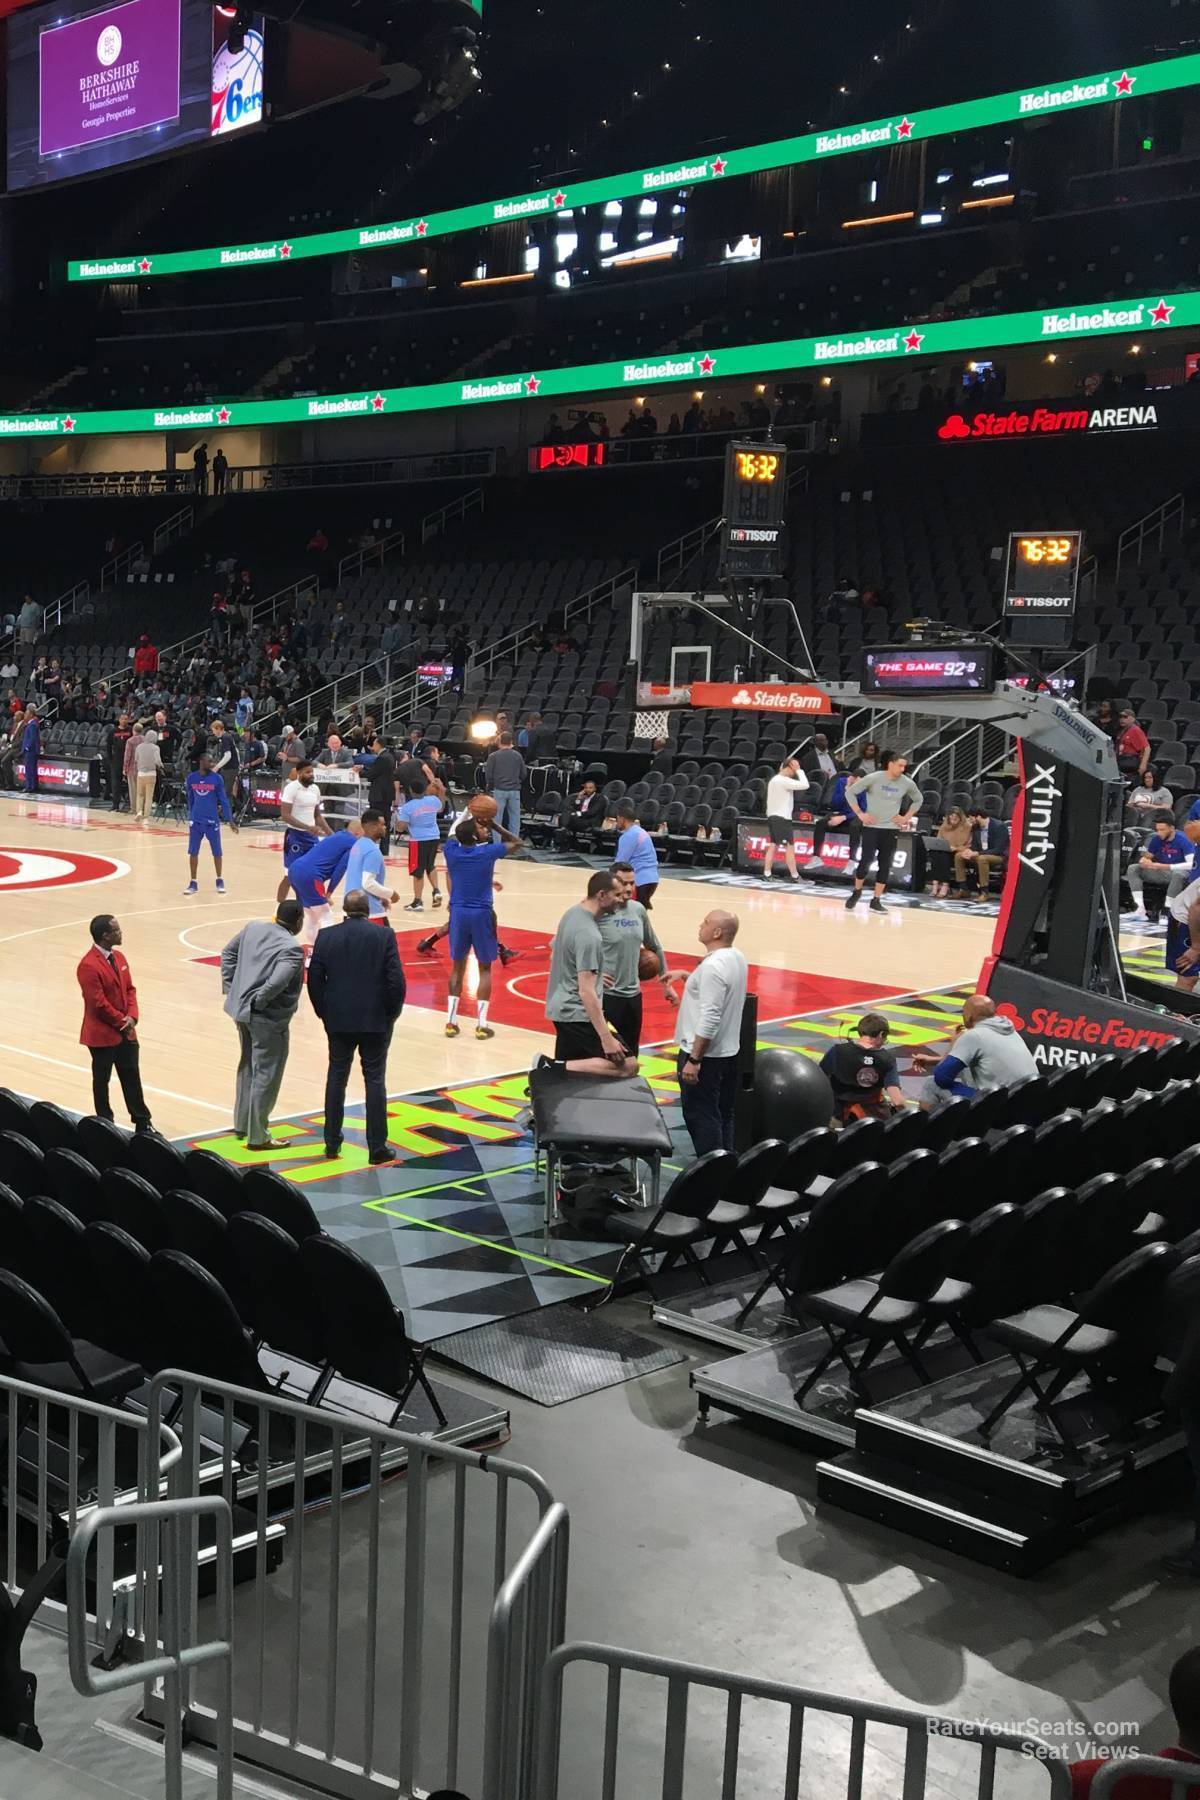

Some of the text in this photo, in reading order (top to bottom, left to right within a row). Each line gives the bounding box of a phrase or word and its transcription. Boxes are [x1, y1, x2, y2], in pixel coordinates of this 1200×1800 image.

[79, 60, 140, 91] BERKSHIRE
[82, 75, 138, 103] HATHAWAY
[1019, 78, 1109, 113] Heineken
[89, 93, 129, 111] HomeServices
[82, 107, 136, 128] Georgia Properties
[816, 122, 893, 153] Heineken
[643, 162, 708, 188] Heineken
[493, 194, 550, 218] Heineken
[359, 224, 414, 244] Heineken
[220, 245, 277, 264] Heineken
[80, 260, 136, 277] Heineken
[1042, 304, 1145, 335] Heineken
[814, 333, 900, 360] Heineken
[624, 357, 696, 381] Heineken
[462, 378, 523, 400] Heineken
[309, 396, 369, 416] Heineken
[1089, 406, 1158, 427] ARENA
[0, 417, 59, 433] Heineken
[154, 409, 214, 426] Heineken
[736, 453, 777, 480] 76:32
[1021, 539, 1071, 561] 76:32
[1025, 597, 1071, 607] TISSOT
[878, 662, 903, 671] THE
[905, 662, 944, 671] GAME
[1052, 704, 1098, 747] SPALDING
[38, 766, 65, 778] GAME
[256, 789, 276, 798] THE
[1018, 763, 1062, 876] xfinity
